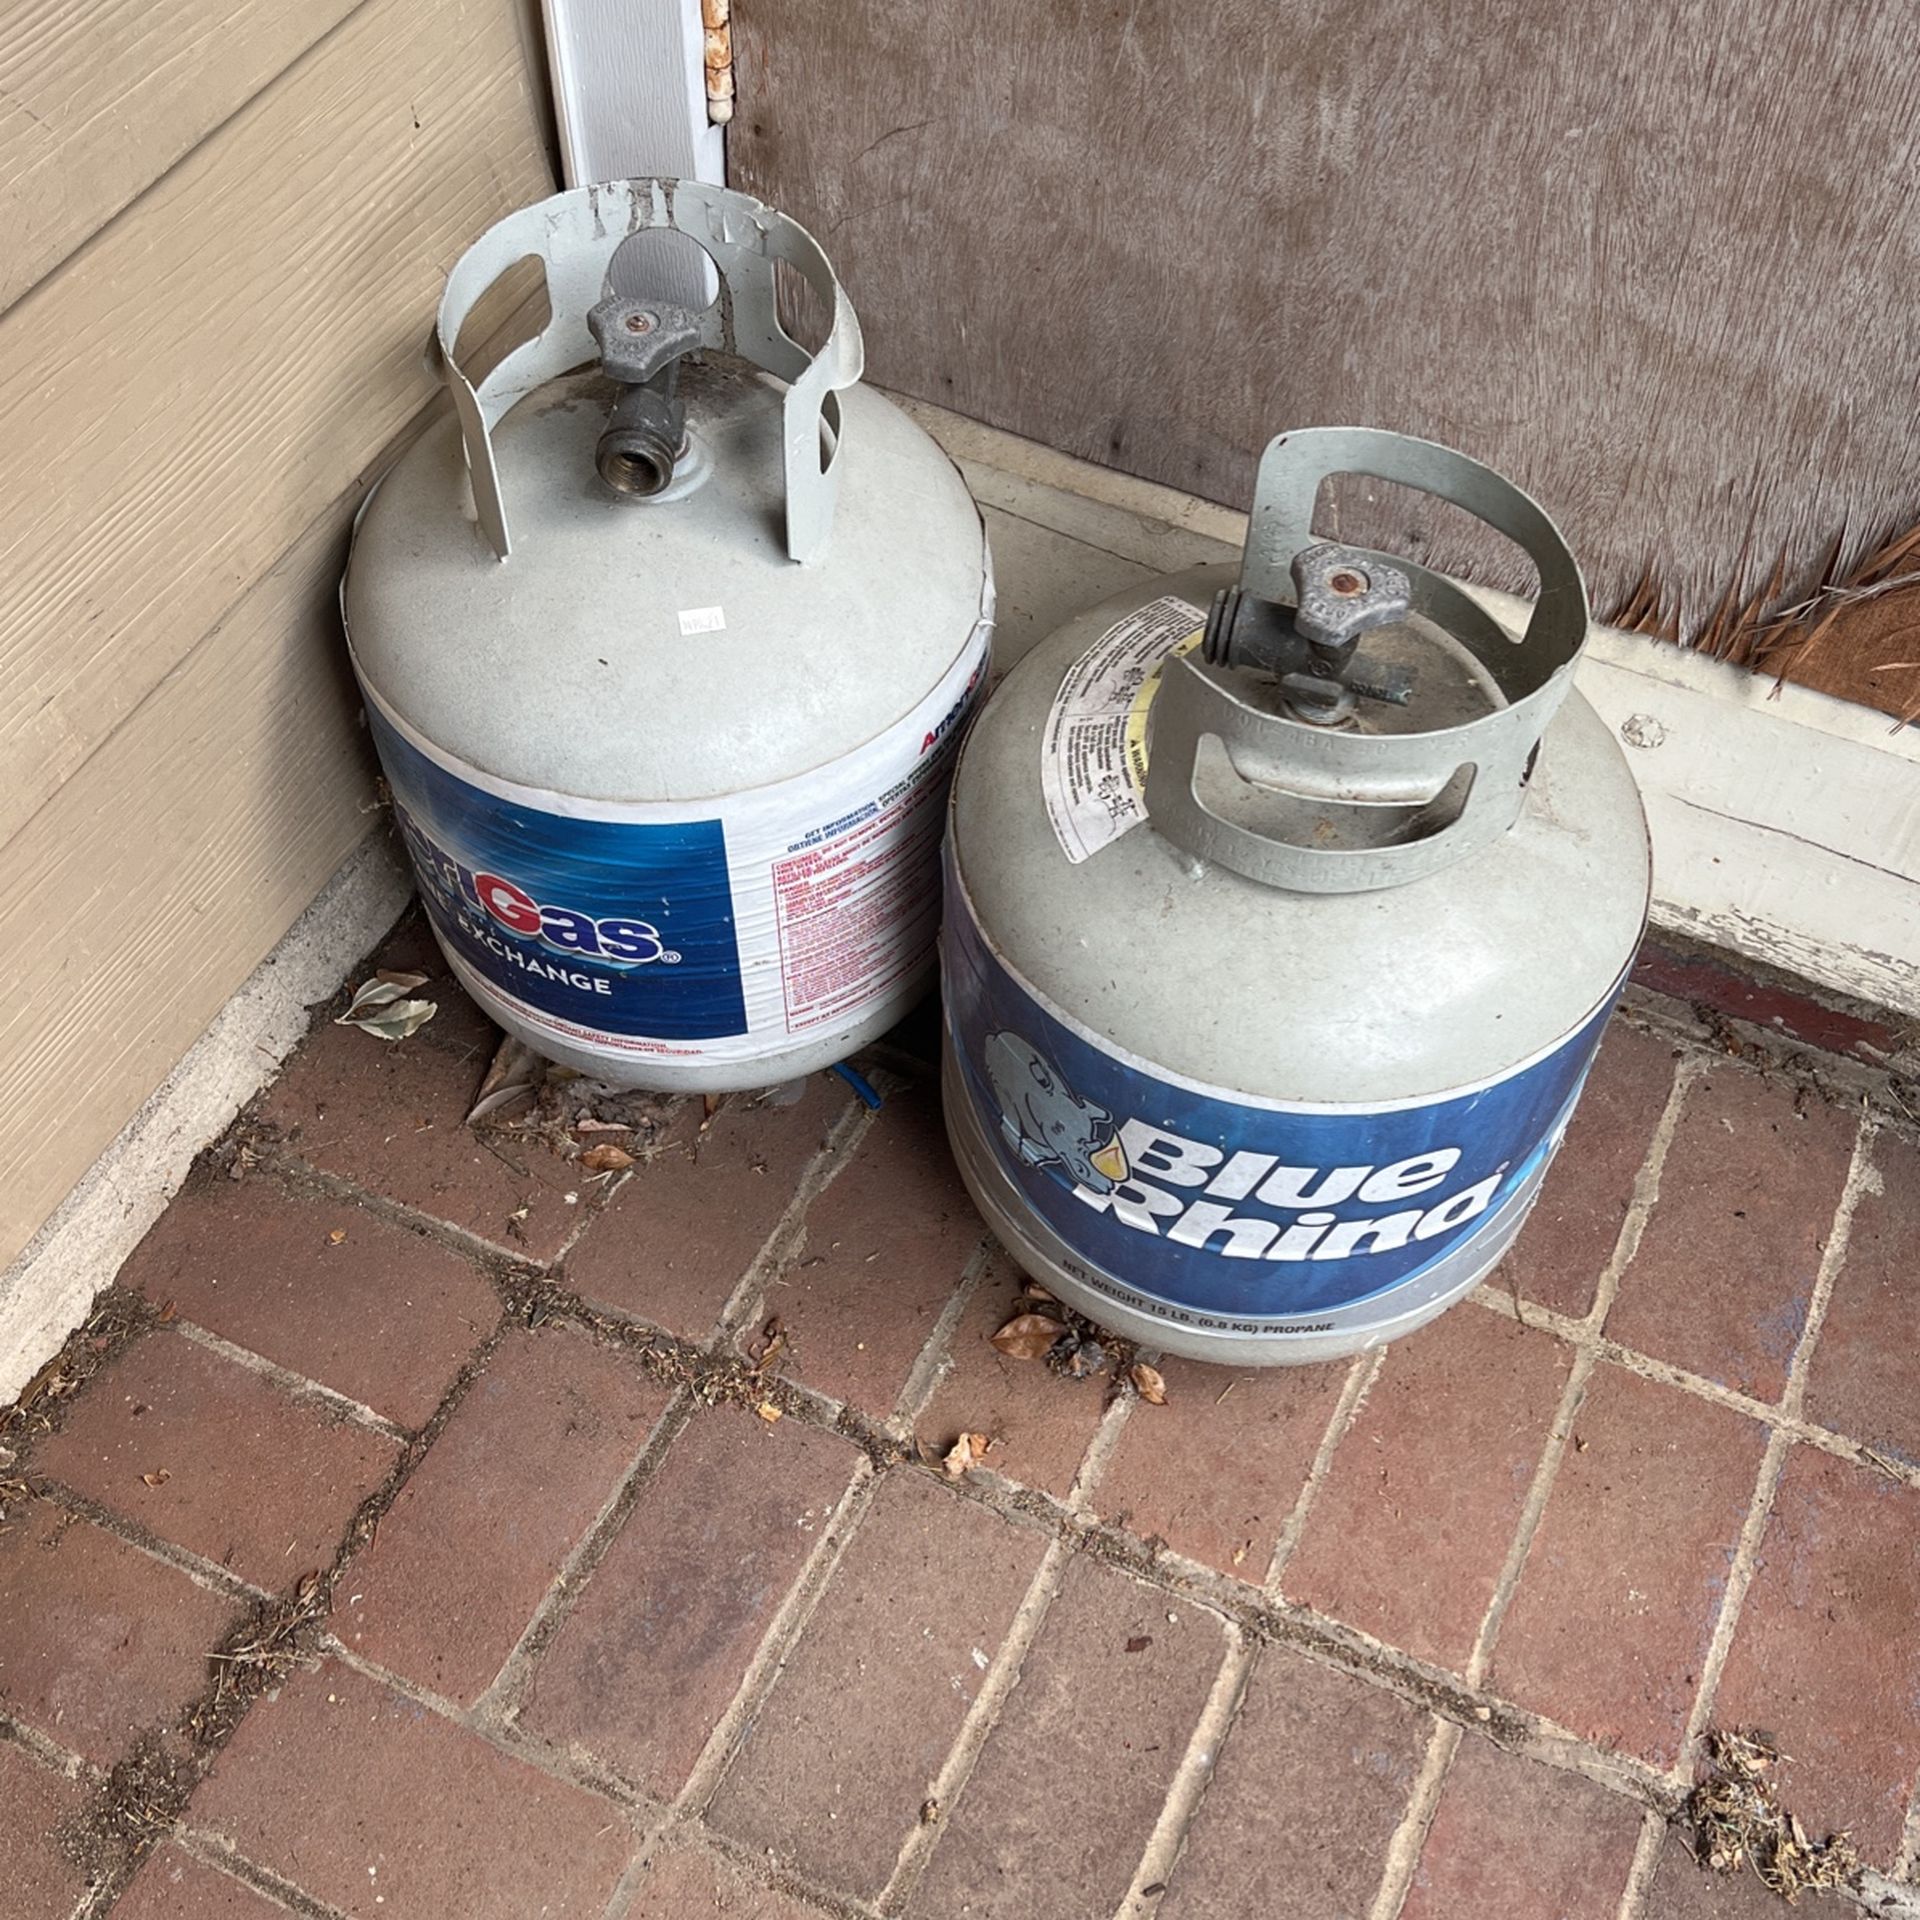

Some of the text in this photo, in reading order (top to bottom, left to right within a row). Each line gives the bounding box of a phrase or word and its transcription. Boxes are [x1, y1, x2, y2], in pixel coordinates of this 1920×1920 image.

[457, 913, 612, 995] EXCHANGE
[1118, 1118, 1462, 1209] Blue
[1072, 1170, 1503, 1261] Rhino
[1062, 1259, 1337, 1335] NET WEIGHT 15 LB. (6.8 KG) PROPANE
